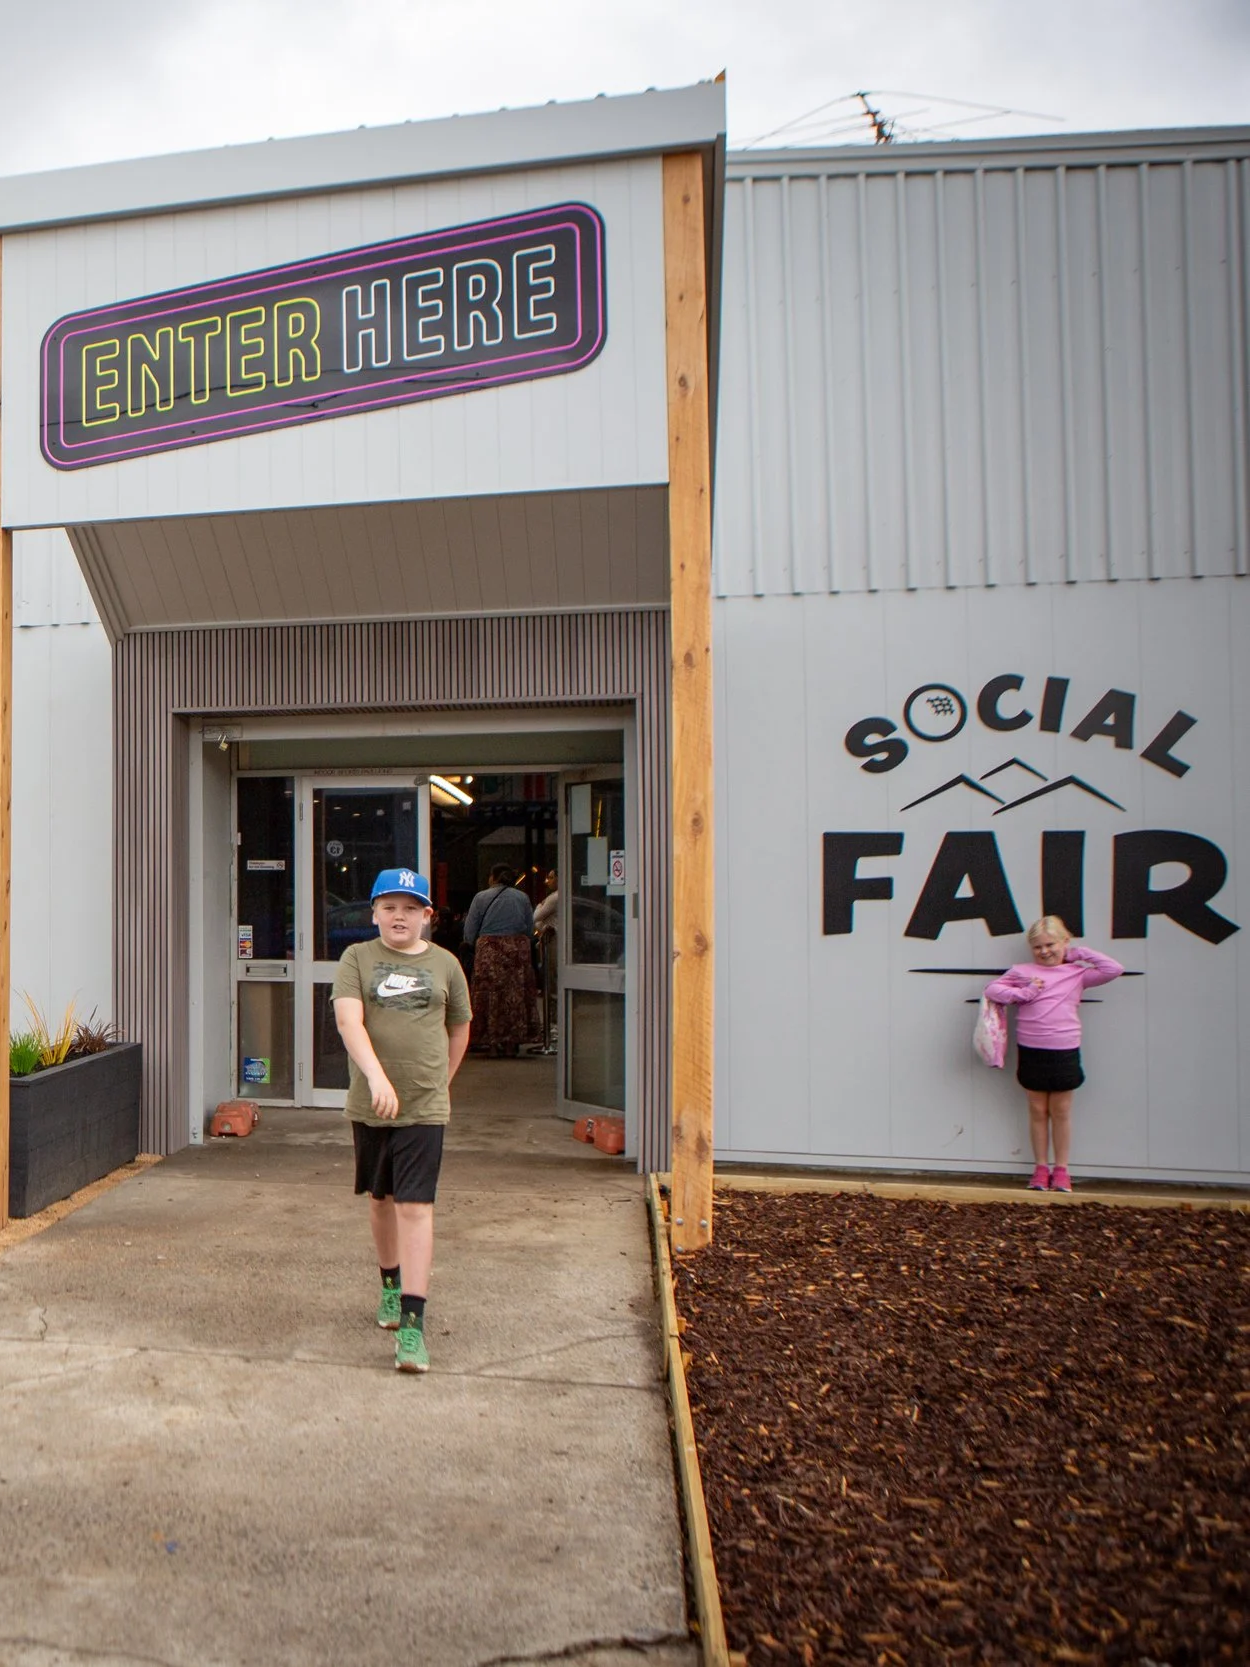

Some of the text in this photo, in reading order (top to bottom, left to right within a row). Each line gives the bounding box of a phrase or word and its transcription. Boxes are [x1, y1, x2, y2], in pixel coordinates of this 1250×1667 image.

[82, 243, 557, 428] ENTER HERE
[844, 673, 1198, 779] SOCIAL
[821, 829, 1242, 945] FAIR
[385, 973, 418, 989] NIKE
